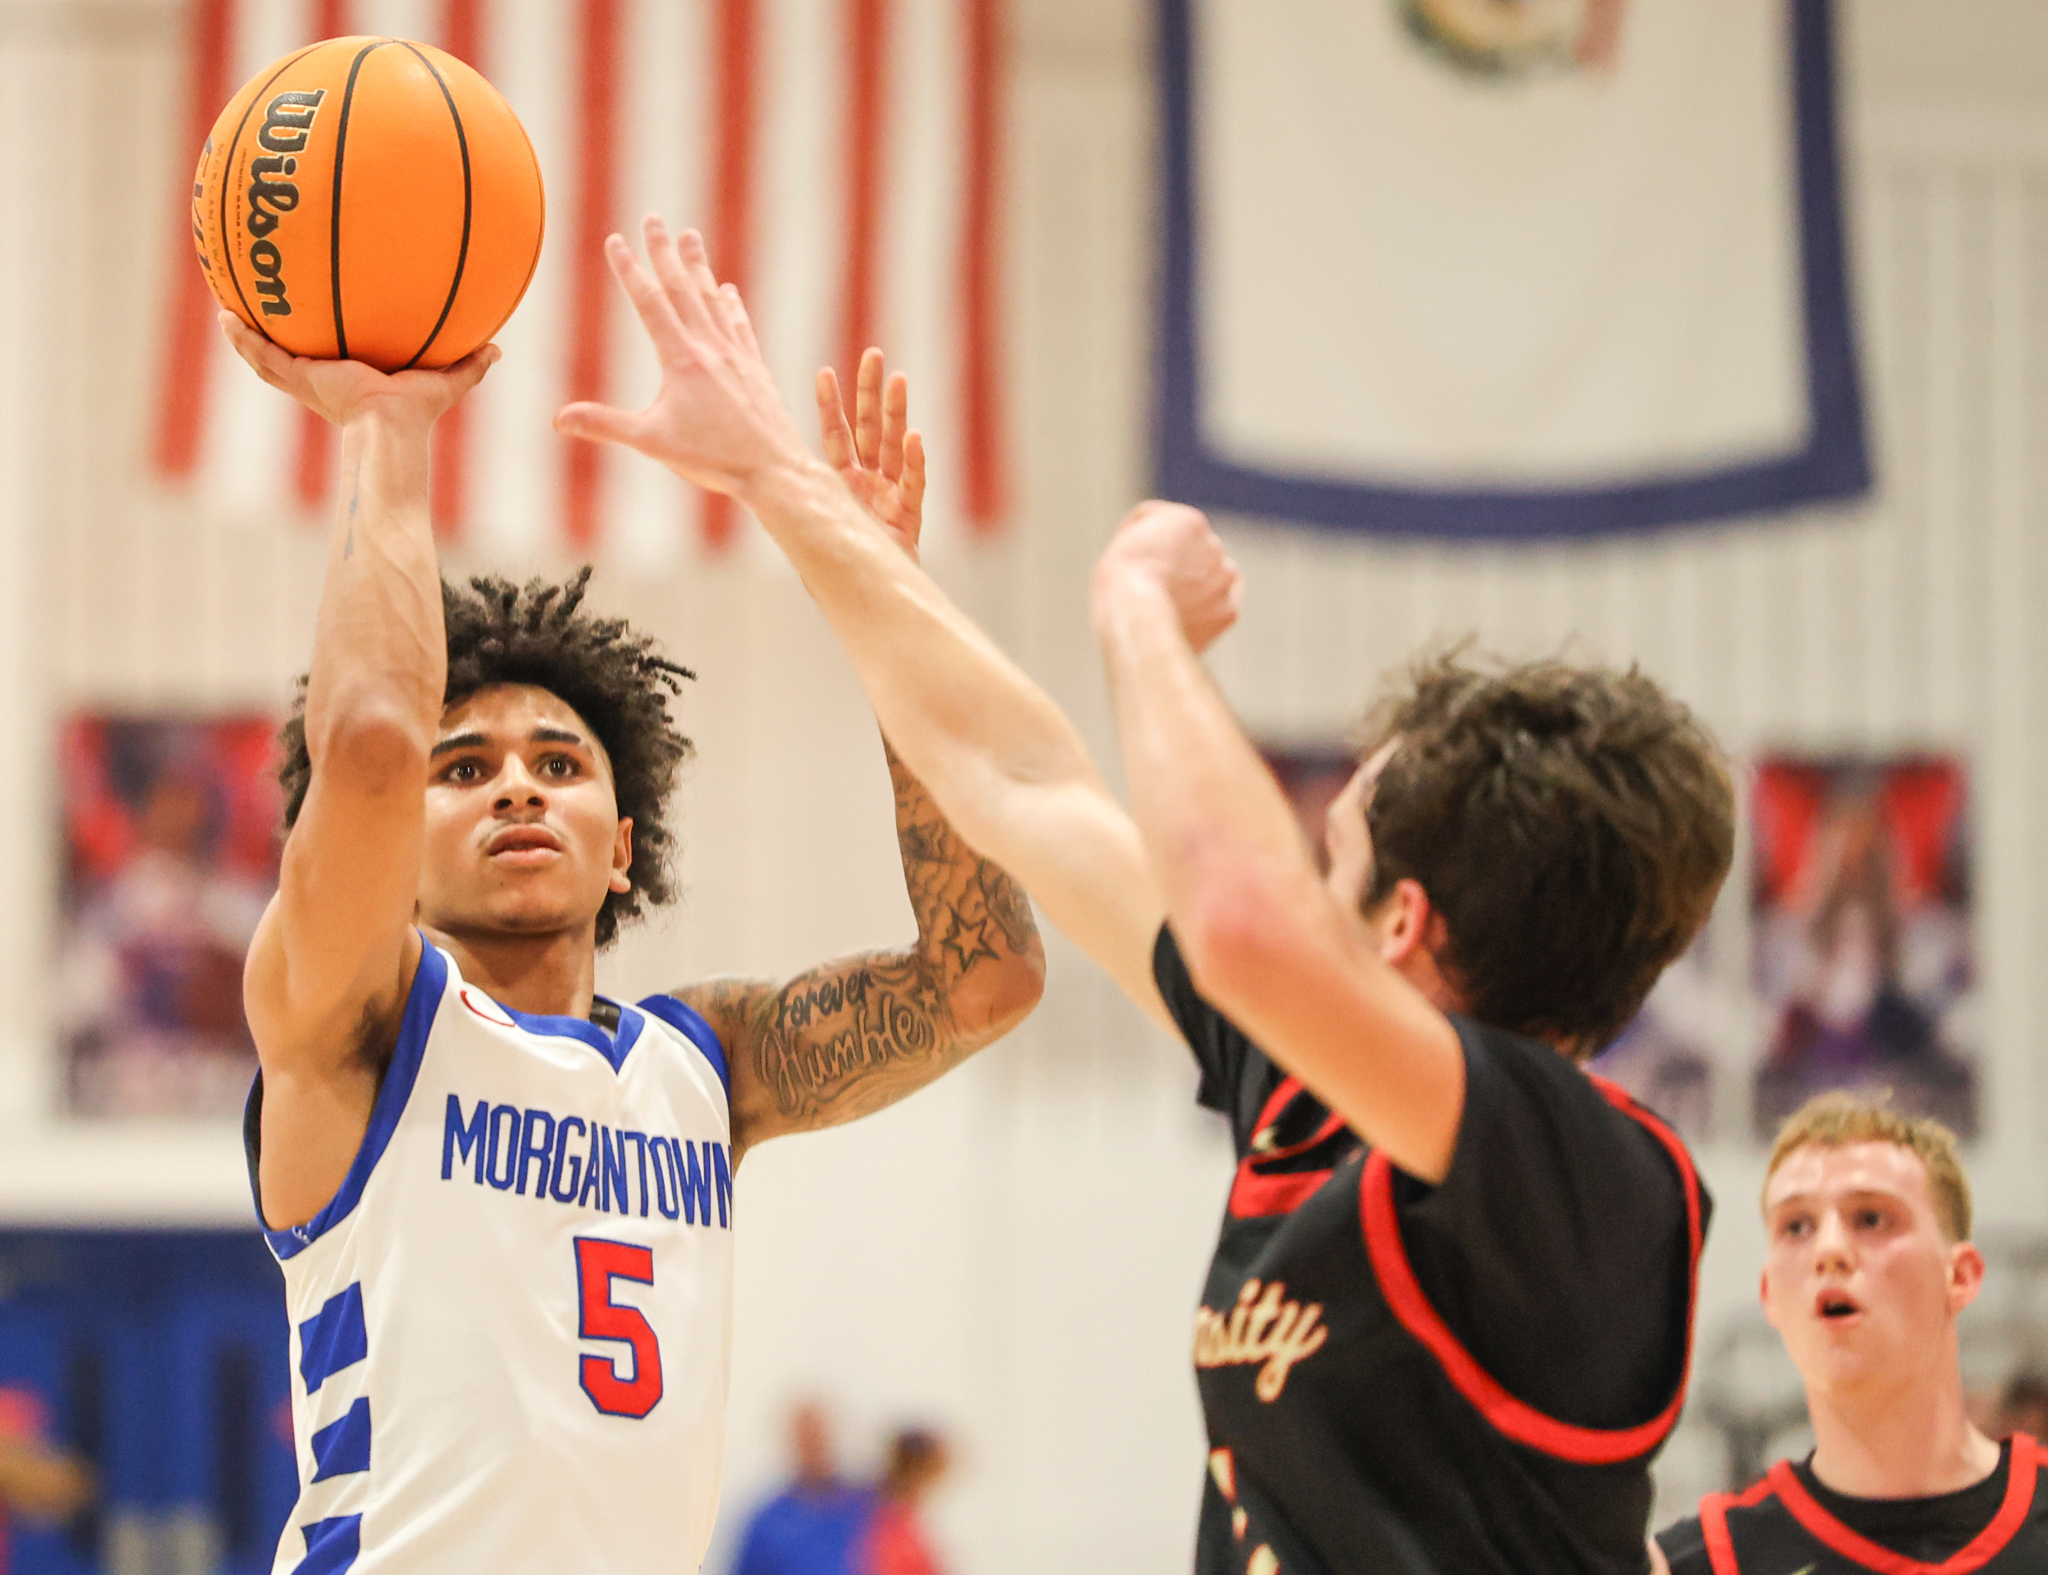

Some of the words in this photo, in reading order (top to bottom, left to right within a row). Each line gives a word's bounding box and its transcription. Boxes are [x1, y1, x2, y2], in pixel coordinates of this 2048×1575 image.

[207, 143, 227, 278] MORGANTOWN
[247, 88, 328, 317] Wilson
[441, 1093, 733, 1231] MORGANTOWN
[573, 1236, 664, 1420] 5
